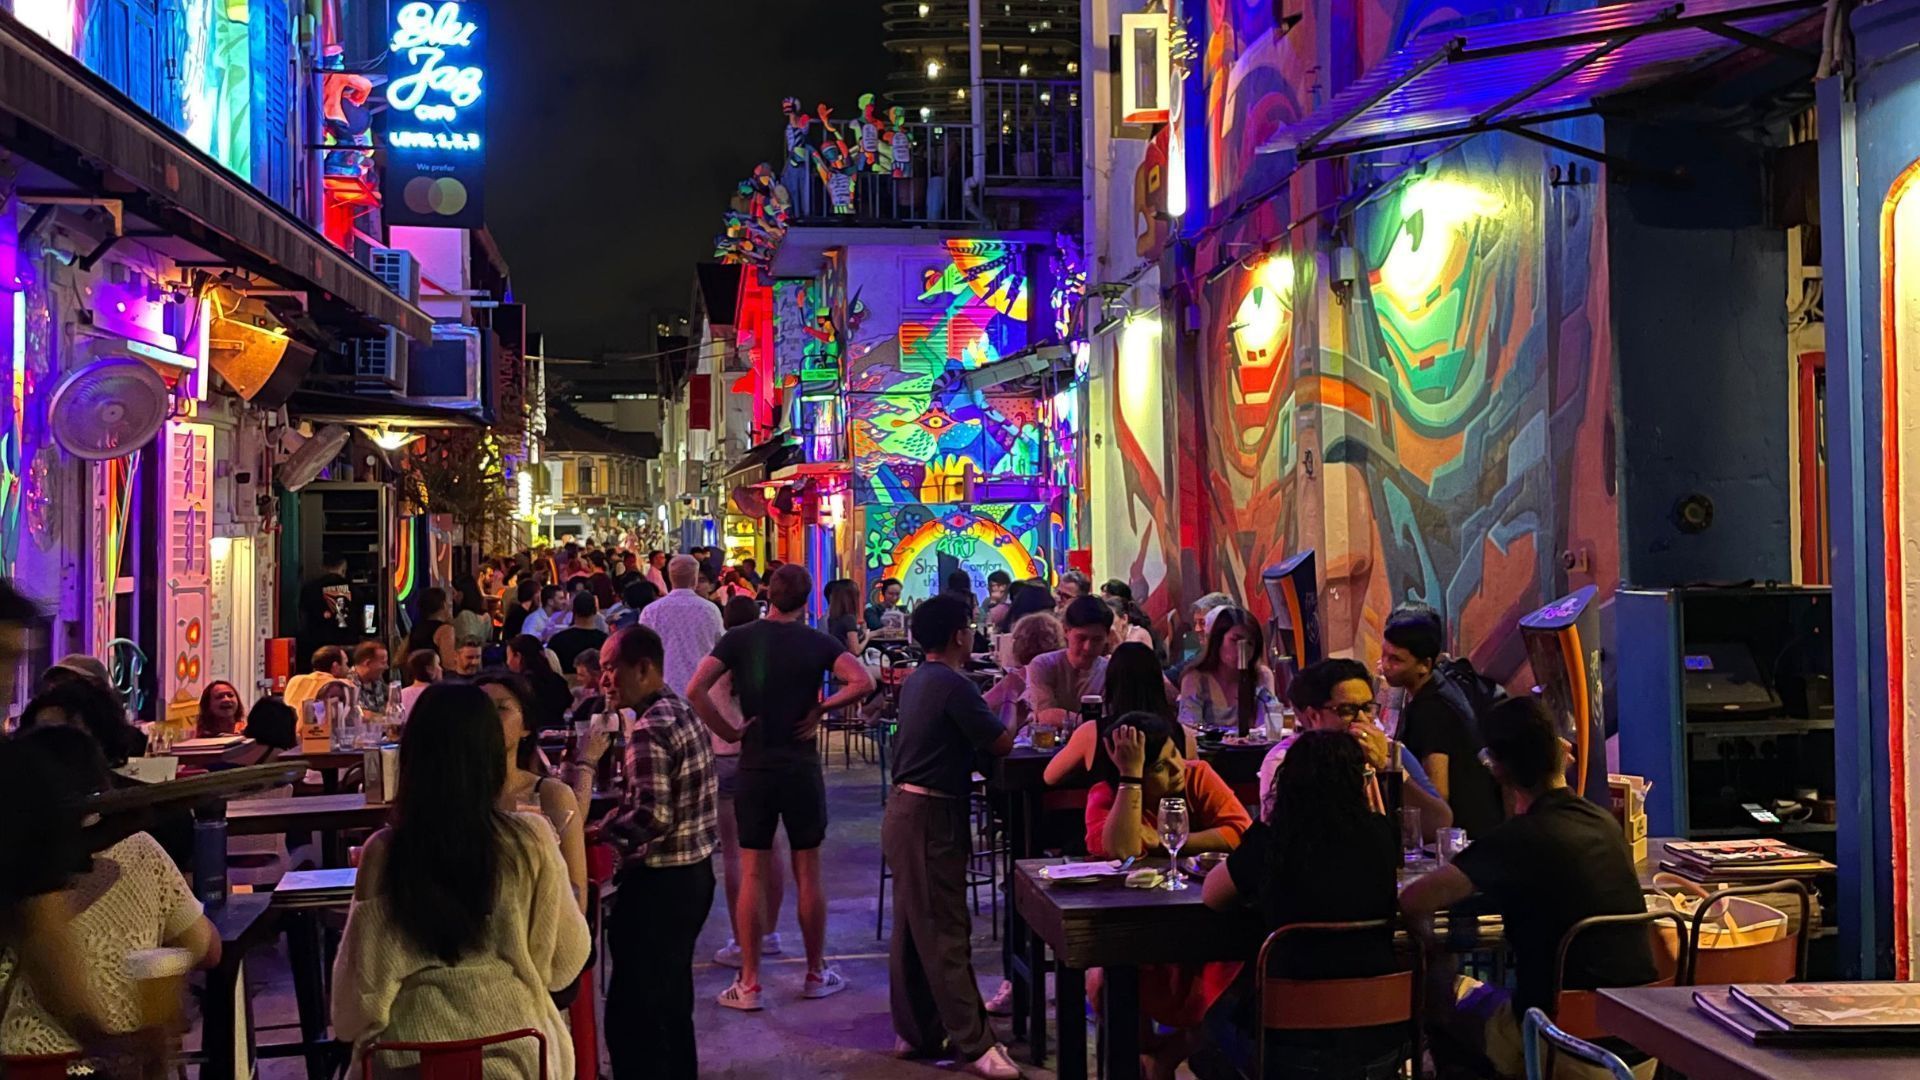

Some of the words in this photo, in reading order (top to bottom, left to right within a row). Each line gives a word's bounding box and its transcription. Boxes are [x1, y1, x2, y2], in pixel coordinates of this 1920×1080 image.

[416, 163, 430, 172] We
[431, 164, 456, 173] prefer
[936, 535, 980, 558] ART
